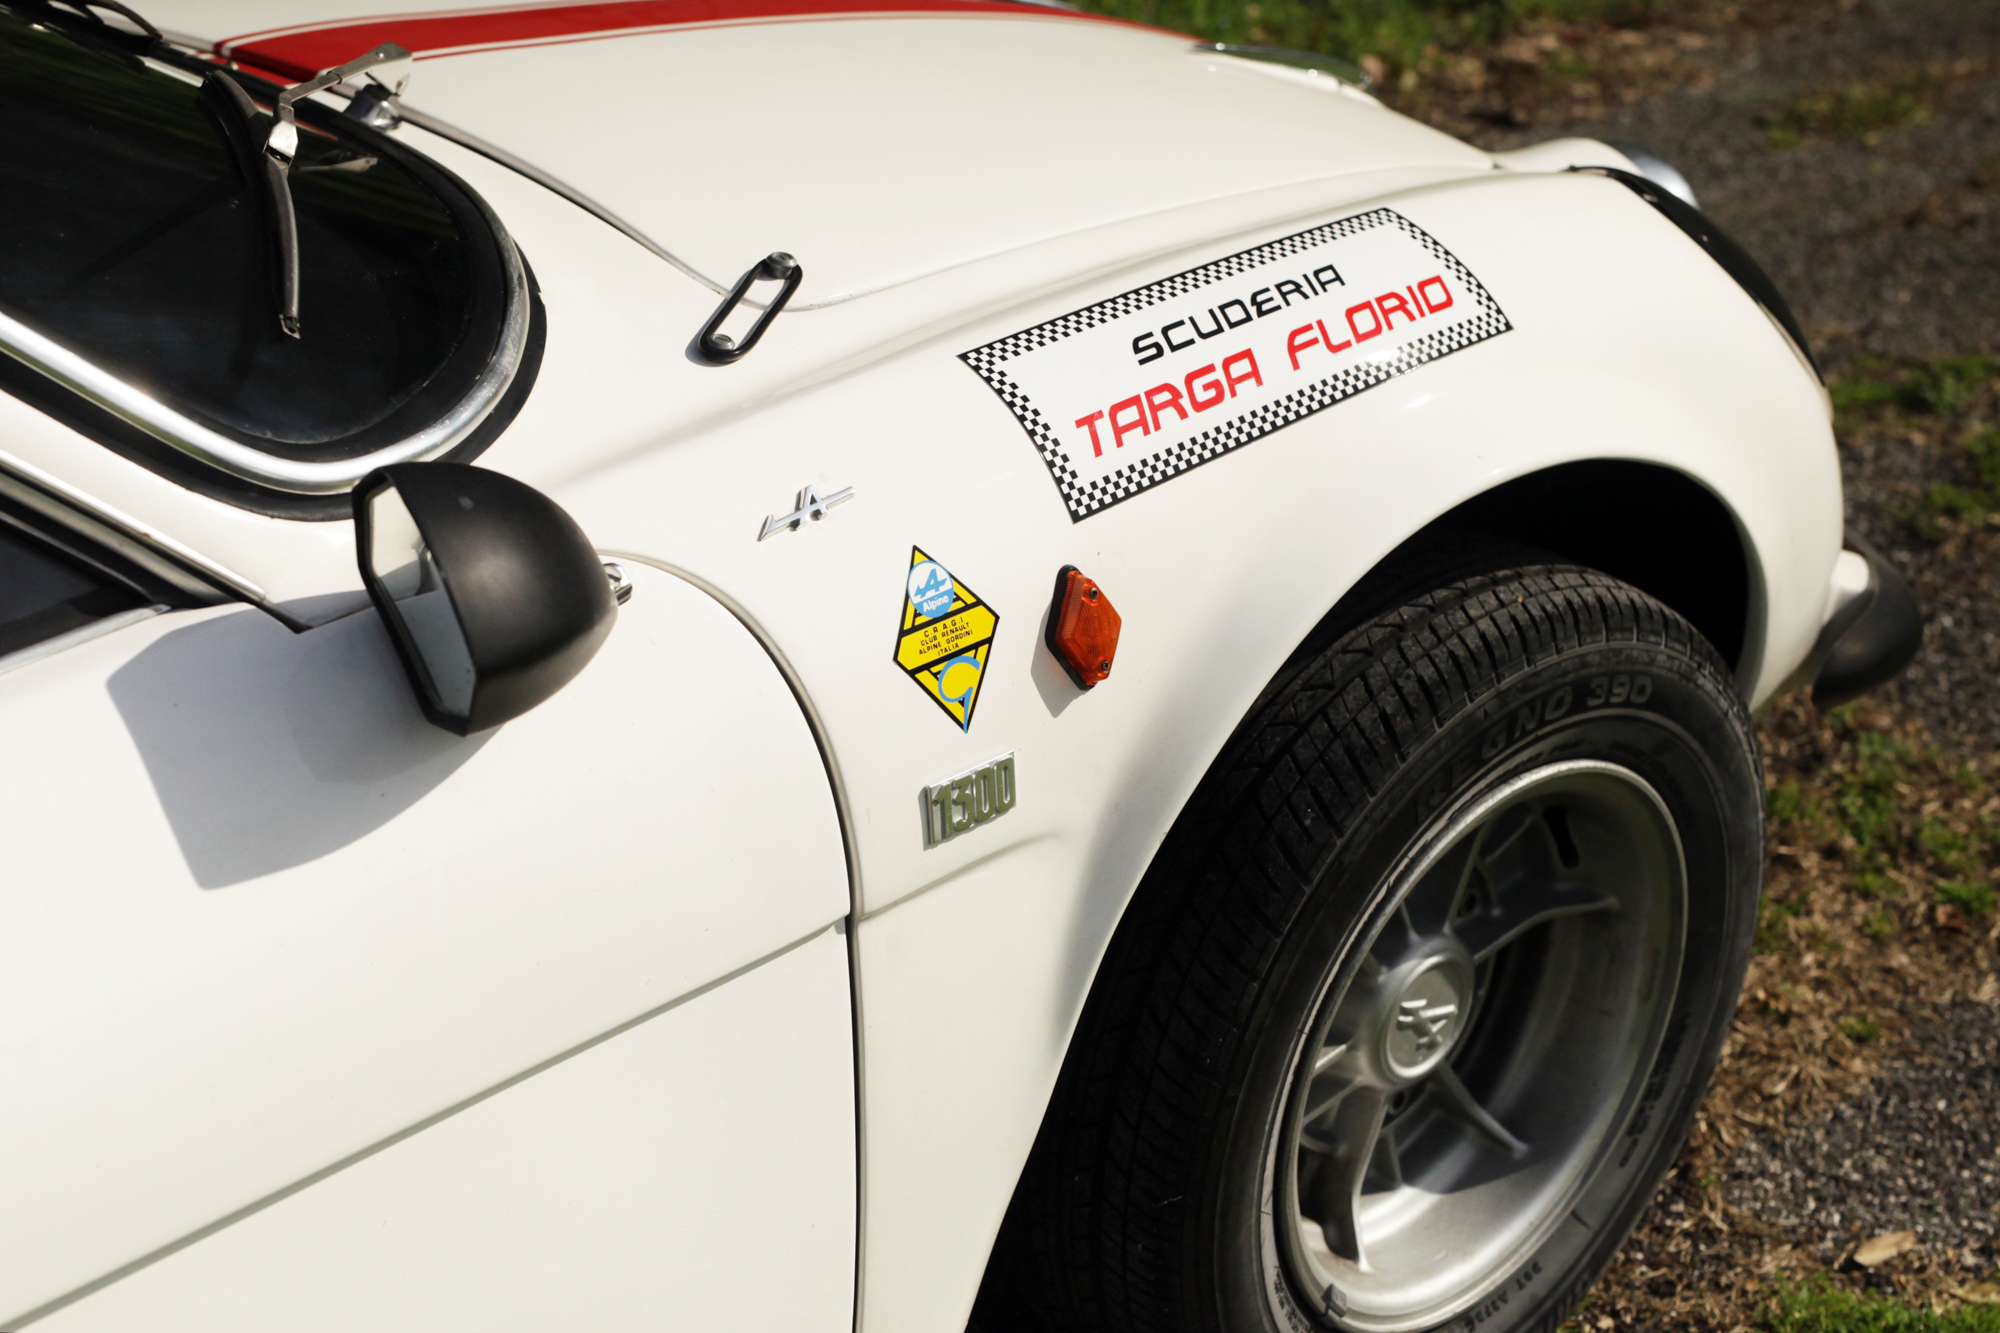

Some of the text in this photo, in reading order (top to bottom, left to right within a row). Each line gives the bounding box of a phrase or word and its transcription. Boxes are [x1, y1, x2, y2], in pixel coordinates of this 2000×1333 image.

[1131, 263, 1346, 366] SCUDERIA
[1074, 274, 1454, 459] TARGA FLORIO
[922, 594, 950, 613] Alpine
[919, 629, 974, 655] ALPINE GORDINI
[920, 622, 970, 647] CLUB RENAULT
[937, 642, 960, 656] ITALIA
[1586, 673, 1653, 707] 390
[929, 755, 1017, 841] 1300
